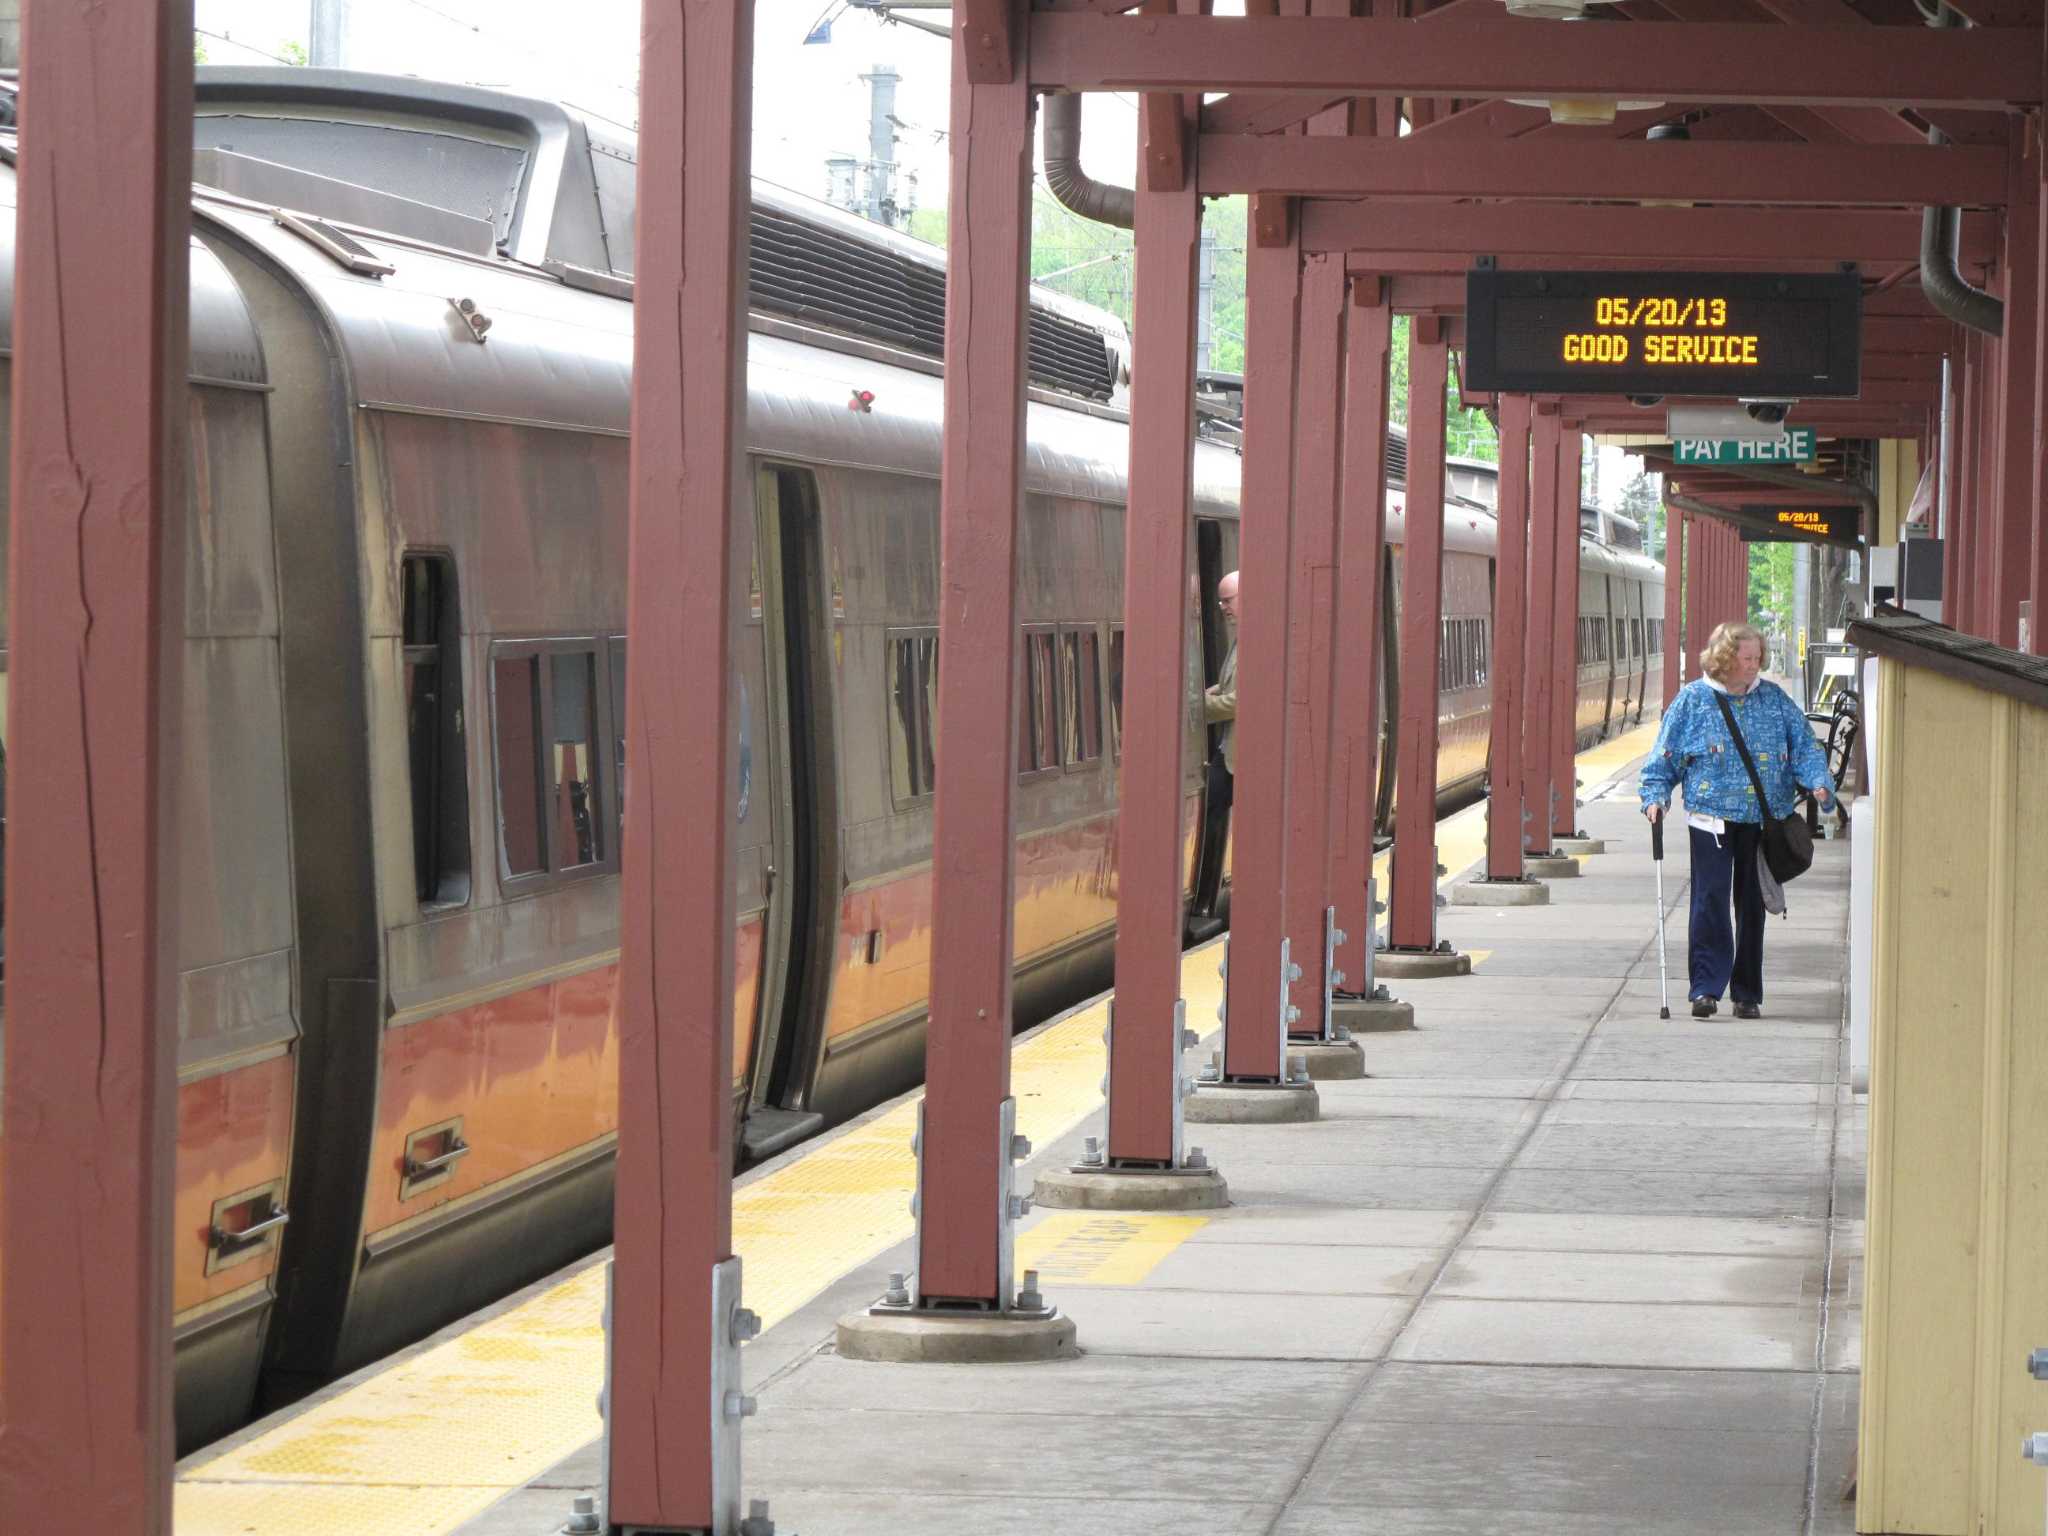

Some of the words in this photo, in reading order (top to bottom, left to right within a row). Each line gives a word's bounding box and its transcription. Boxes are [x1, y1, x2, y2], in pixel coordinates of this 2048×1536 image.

[1596, 298, 1727, 326] 05/20/13
[1563, 334, 1629, 362] GOOD
[1644, 335, 1759, 363] SERVICE
[1680, 440, 1723, 460] PAY
[1738, 432, 1809, 459] HERE
